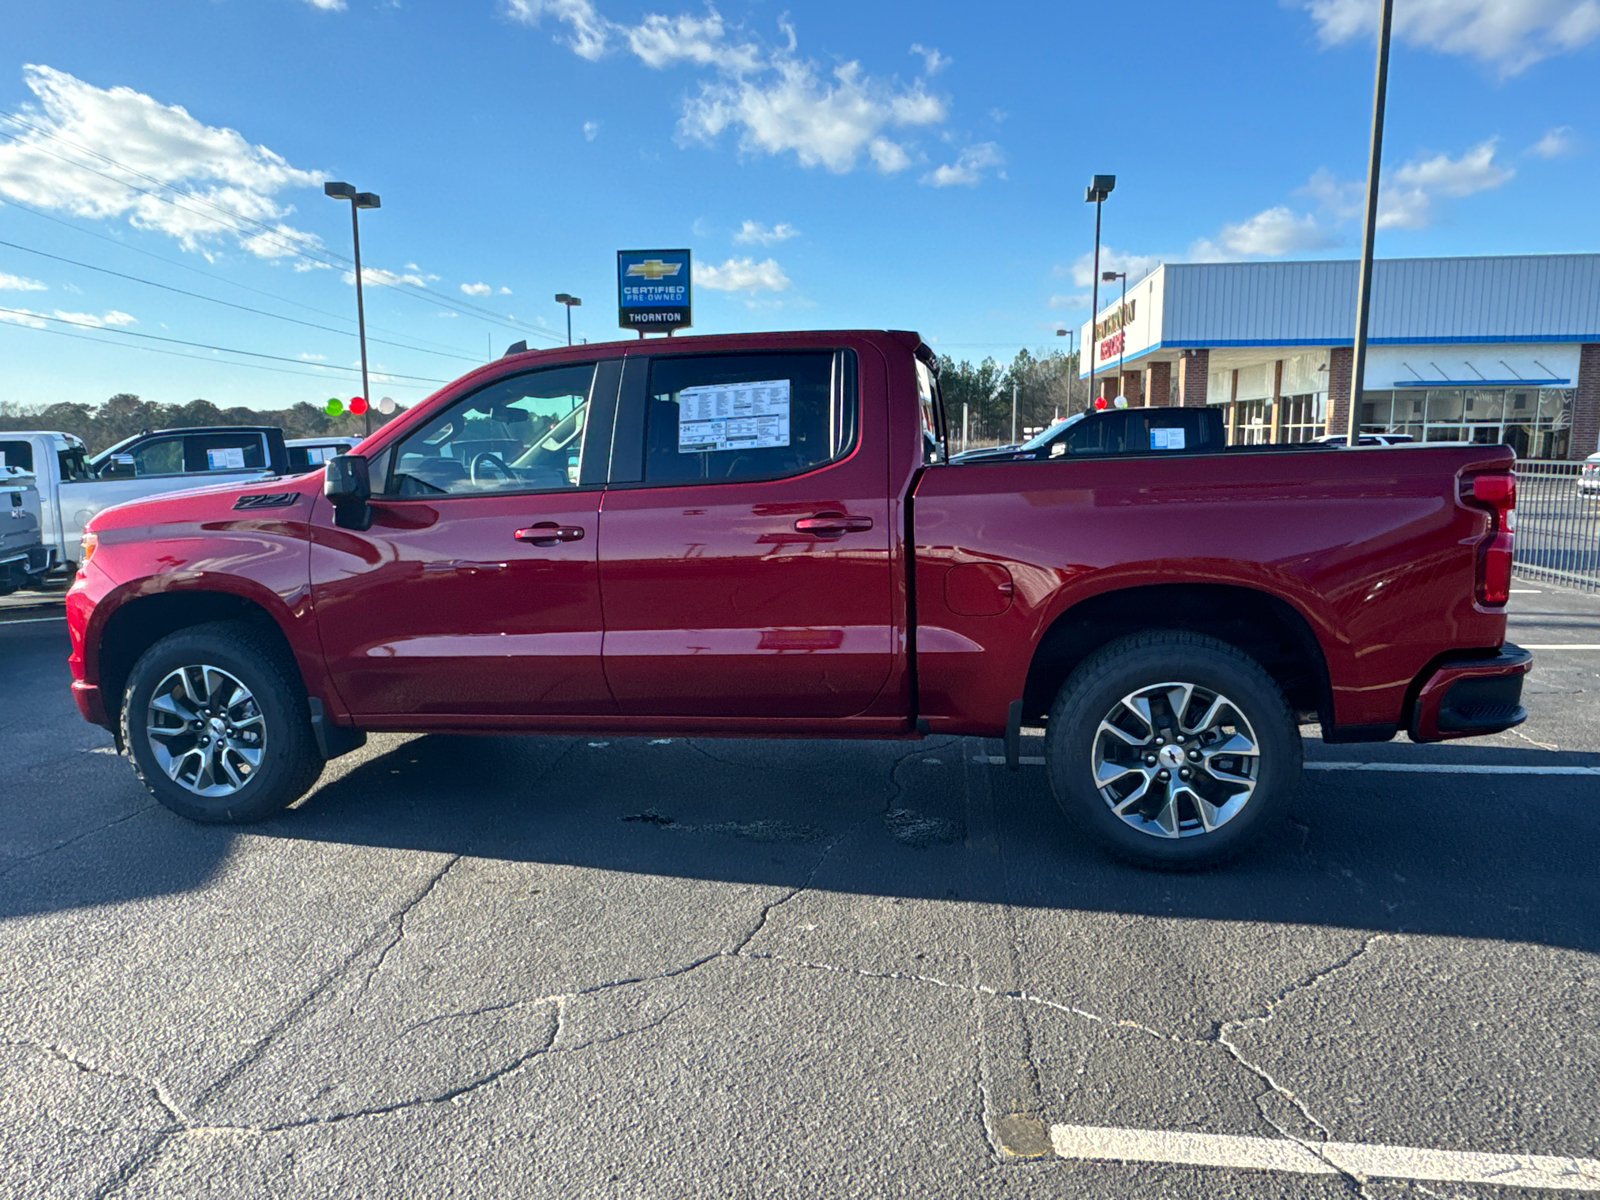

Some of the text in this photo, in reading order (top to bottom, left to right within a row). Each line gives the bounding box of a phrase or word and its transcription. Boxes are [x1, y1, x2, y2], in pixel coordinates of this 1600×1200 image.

[623, 286, 685, 294] CERTIFIED
[626, 293, 683, 301] PRE-OWNED
[629, 312, 681, 322] THORNTON
[232, 492, 301, 510] Z71
